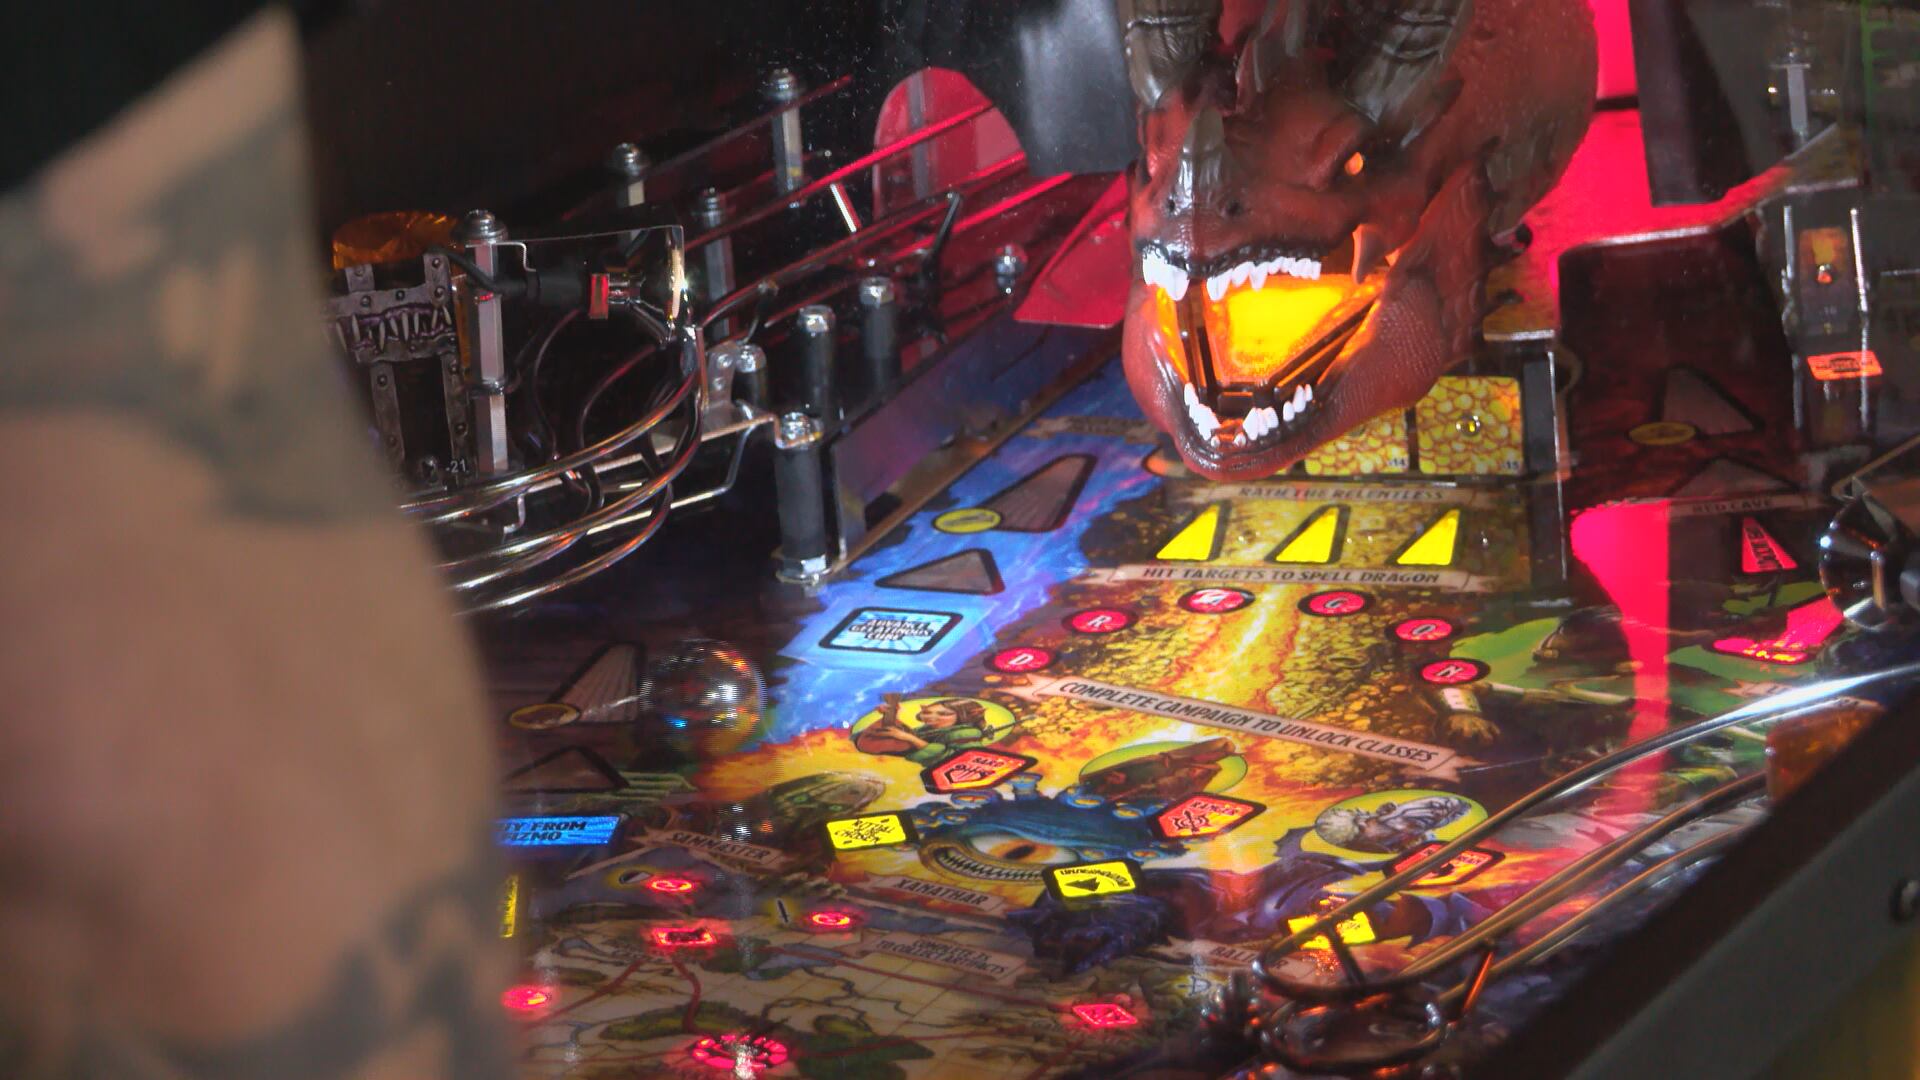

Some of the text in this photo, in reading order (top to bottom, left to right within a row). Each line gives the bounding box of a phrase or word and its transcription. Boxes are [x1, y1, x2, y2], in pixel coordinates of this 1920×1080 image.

[1143, 567, 1441, 584] HIT TARGETS TO SPELL DRAGON
[1087, 614, 1113, 629] R
[1059, 681, 1439, 763] COMPLETE CAMPAIGN TO UNLOCK CLASSES
[530, 821, 587, 831] FROM
[893, 879, 990, 906] XANATHAR
